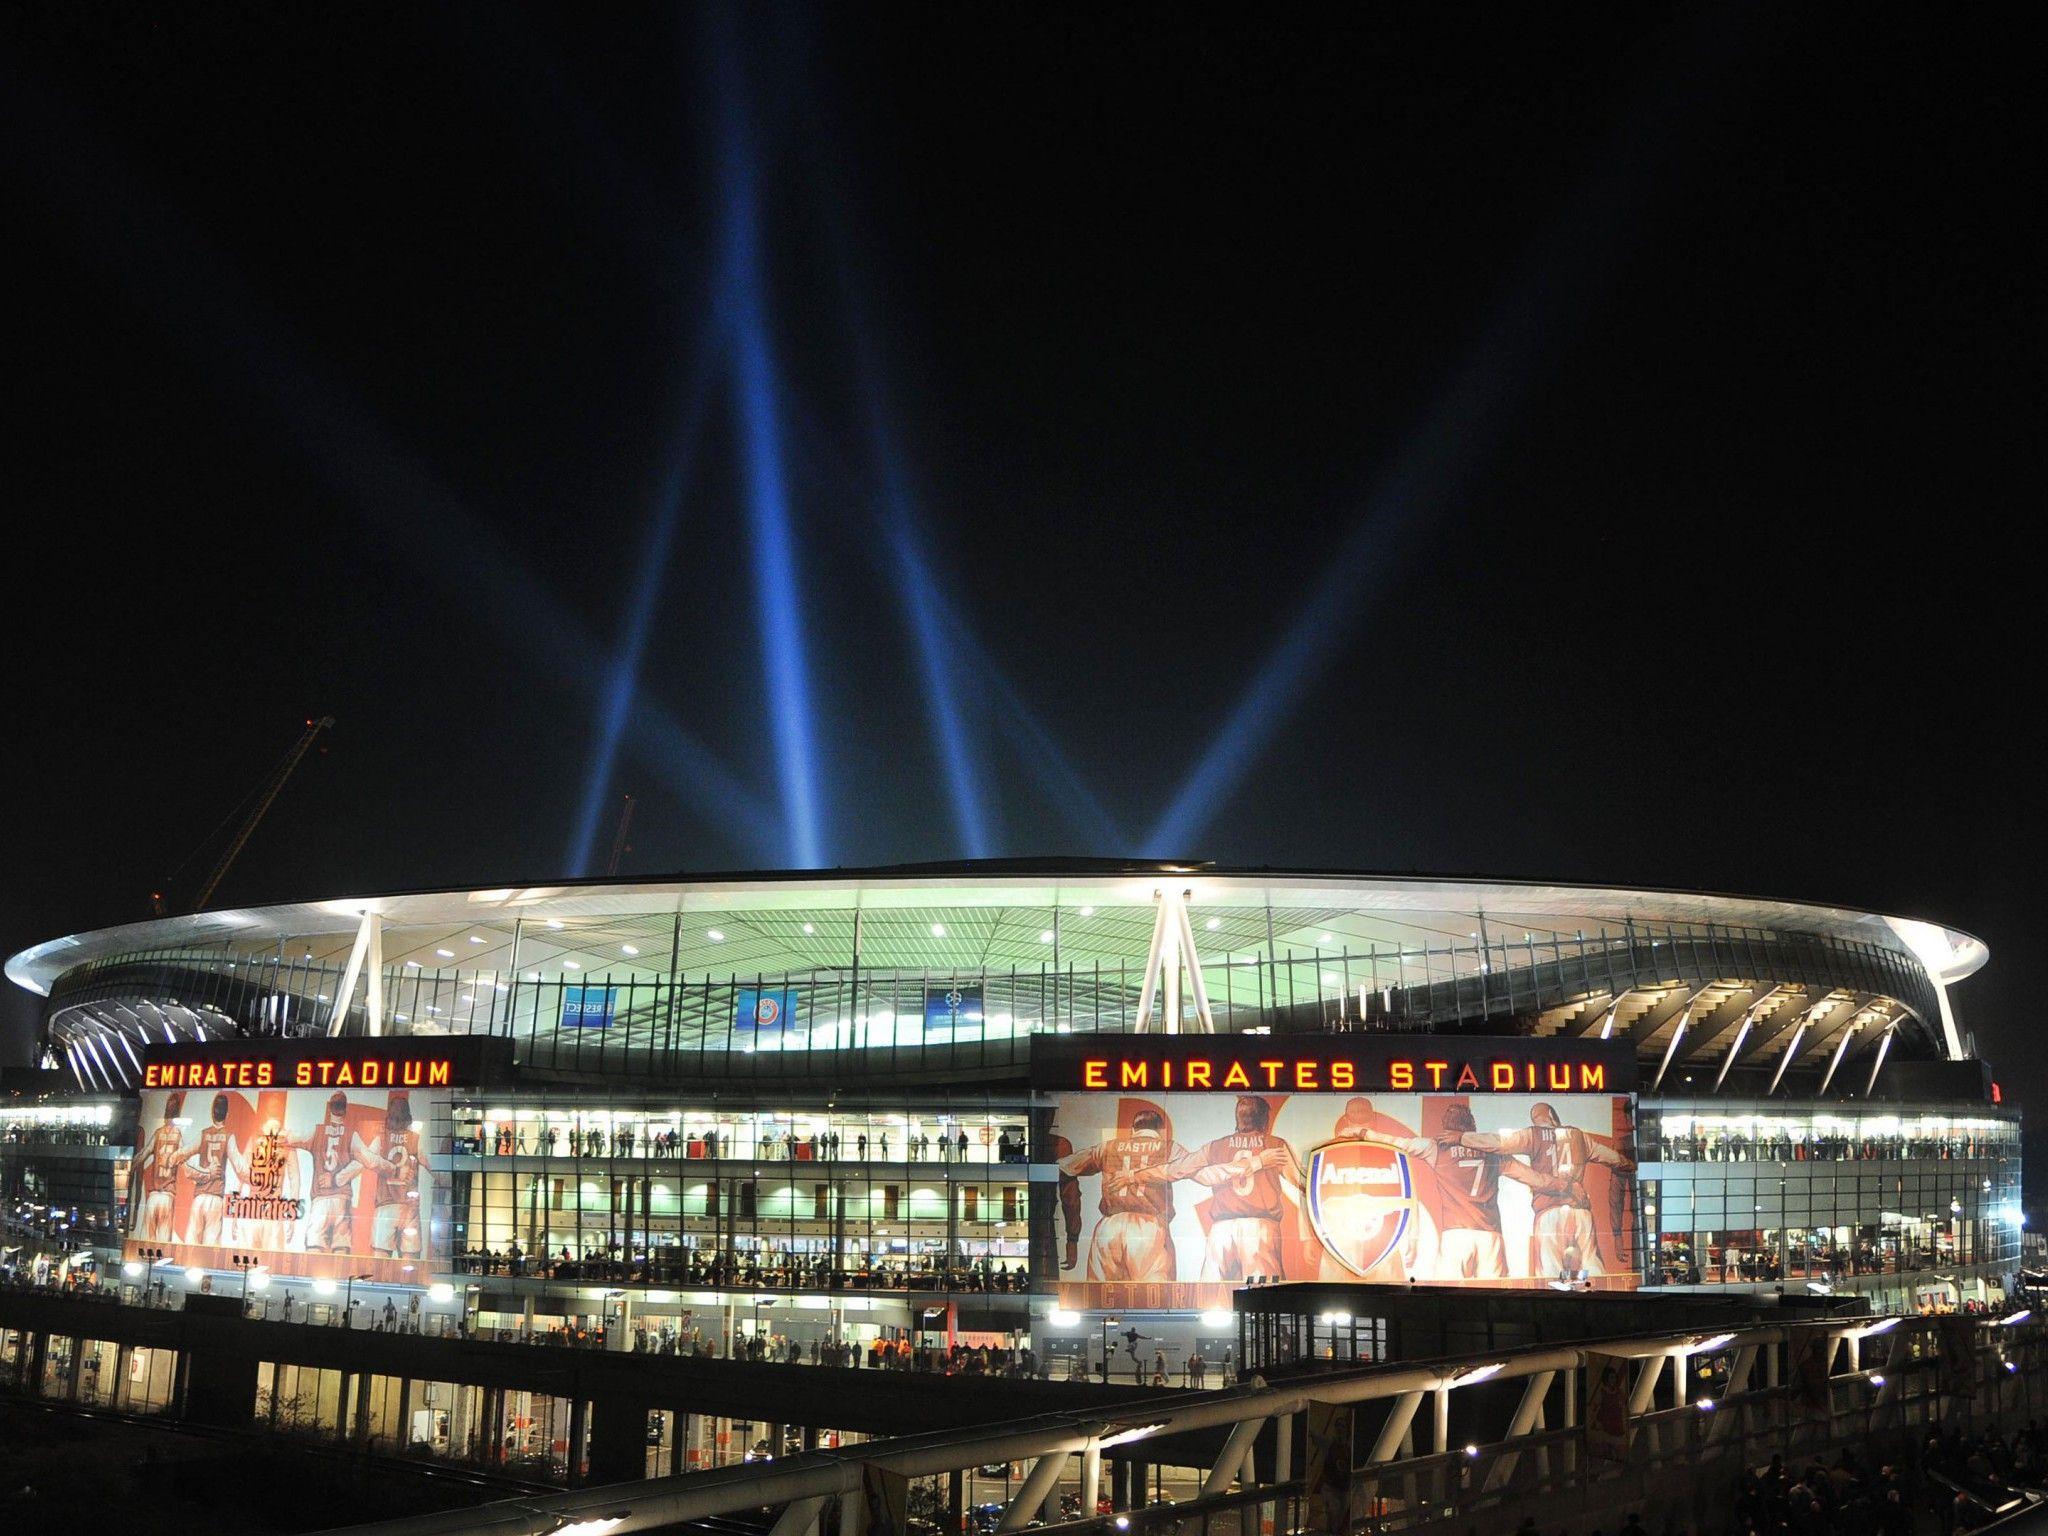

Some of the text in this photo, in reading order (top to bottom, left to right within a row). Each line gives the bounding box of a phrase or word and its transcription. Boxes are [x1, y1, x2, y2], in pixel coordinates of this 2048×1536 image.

[145, 1061, 450, 1087] EMIRATES STADIUM
[1085, 1060, 1605, 1090] EMIRATES STADIUM
[390, 1133, 408, 1143] RICE
[1117, 1141, 1162, 1152] BASTIN
[1229, 1136, 1264, 1149] ADAMS
[1457, 1159, 1485, 1197] 7
[224, 1191, 299, 1220] Emirates
[1058, 1283, 1230, 1309] VICTORIA
